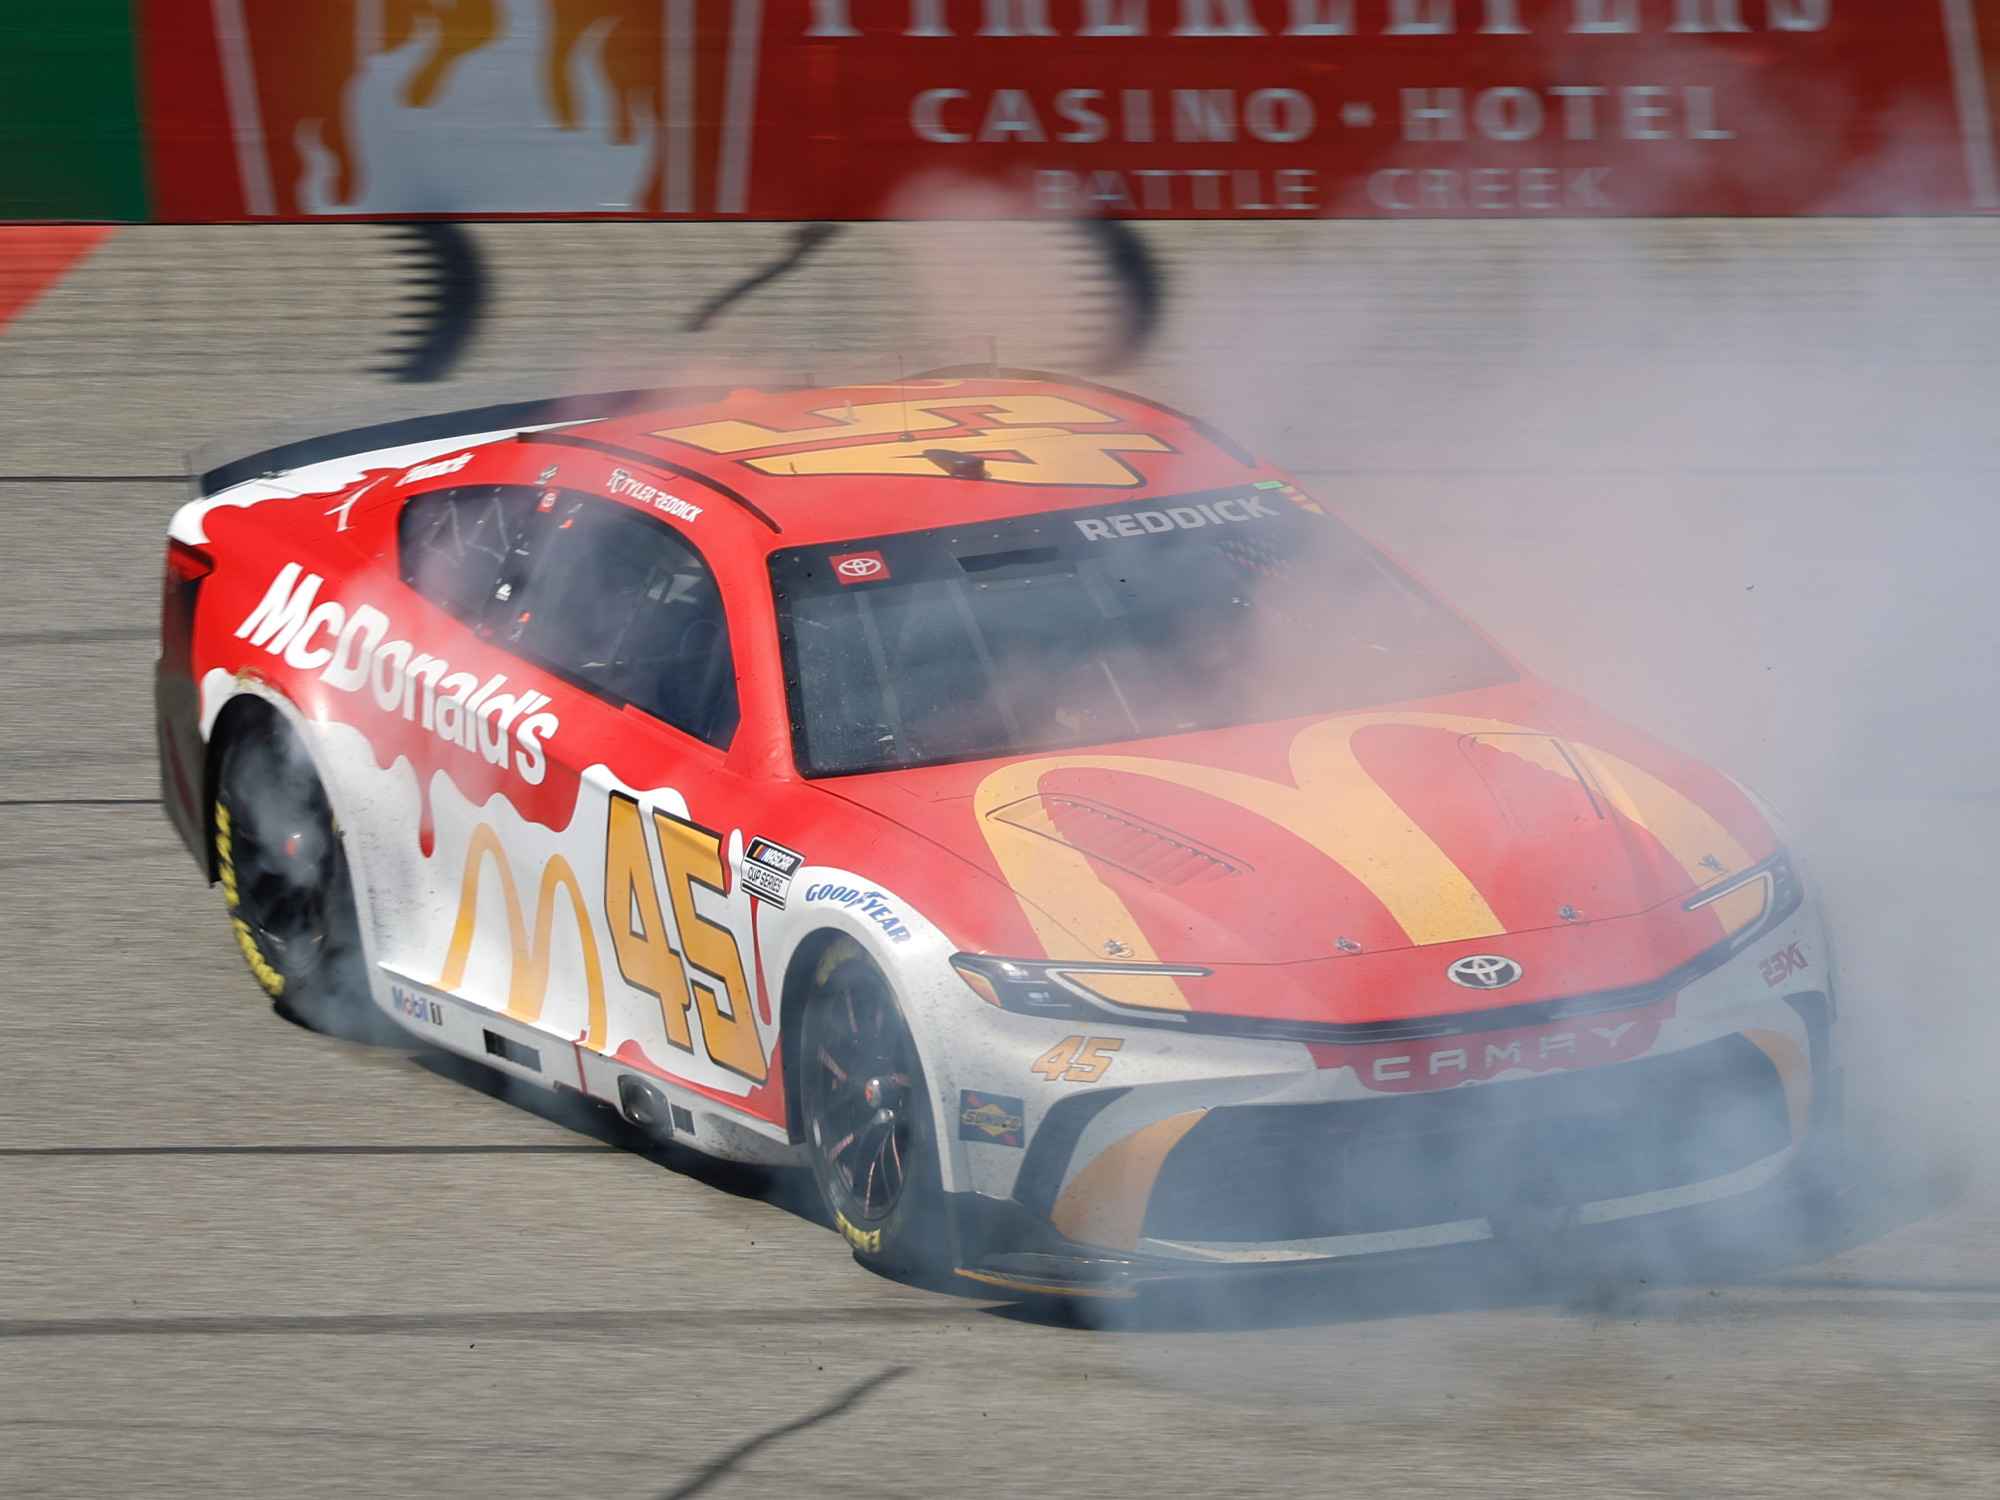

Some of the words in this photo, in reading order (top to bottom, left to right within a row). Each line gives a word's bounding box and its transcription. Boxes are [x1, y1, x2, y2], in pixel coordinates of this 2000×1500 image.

[910, 88, 1317, 143] CASINO
[1400, 85, 1738, 141] HOTEL
[1033, 169, 1319, 211] BATTLE
[1366, 167, 1615, 210] CREEK
[620, 478, 657, 503] TYLER
[655, 491, 704, 523] REDDICK
[1073, 495, 1281, 542] REDDICK
[234, 561, 560, 786] McDonald's
[747, 866, 762, 882] CUP
[760, 871, 784, 893] SERIES
[760, 846, 797, 873] NASCAR
[805, 883, 913, 942] GOODYEAR
[604, 788, 769, 1087] 45
[1030, 1034, 1127, 1083] 45
[1372, 1021, 1639, 1082] CAMRY
